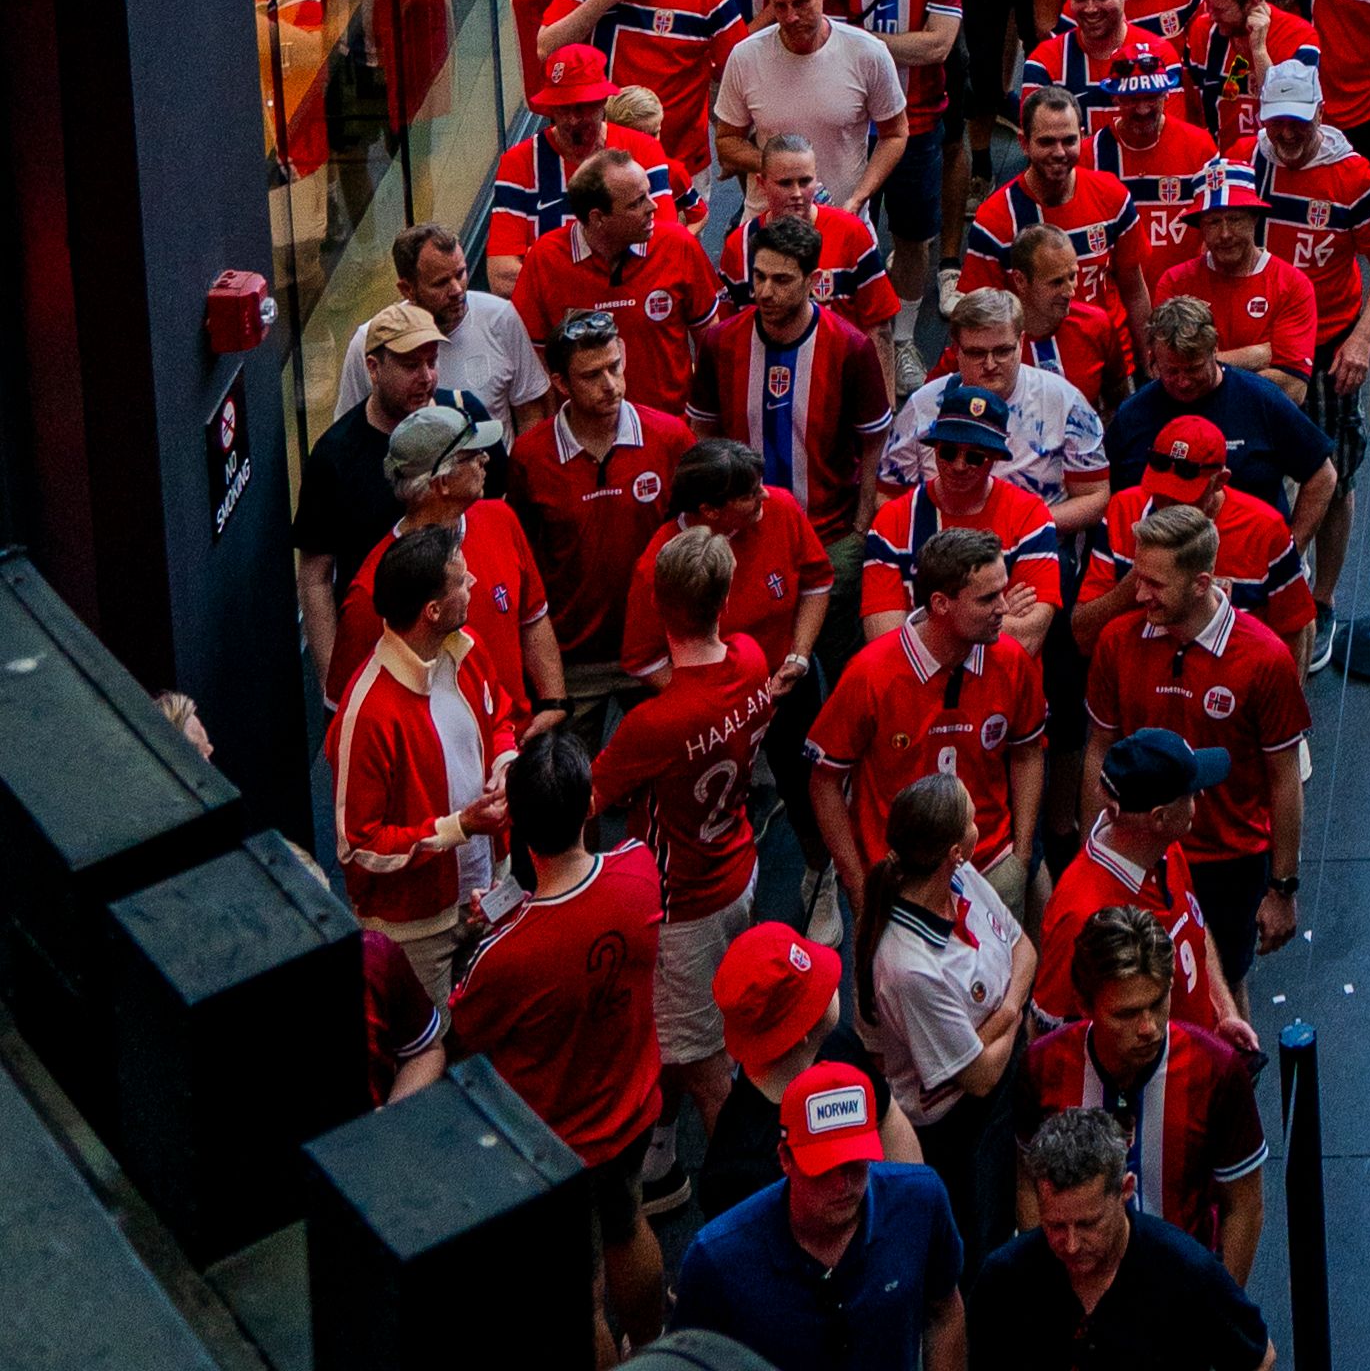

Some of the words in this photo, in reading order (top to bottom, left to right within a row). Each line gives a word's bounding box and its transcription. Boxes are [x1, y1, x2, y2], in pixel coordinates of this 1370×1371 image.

[1150, 209, 1187, 247] 26
[1292, 232, 1336, 268] 26
[594, 299, 636, 310] UMBRO
[225, 450, 237, 485] NO
[216, 457, 251, 534] SMOKING
[582, 488, 623, 501] UMBRO
[685, 676, 773, 761] HAALAN
[1180, 939, 1198, 994] 9
[816, 1098, 859, 1121] NORWAY
